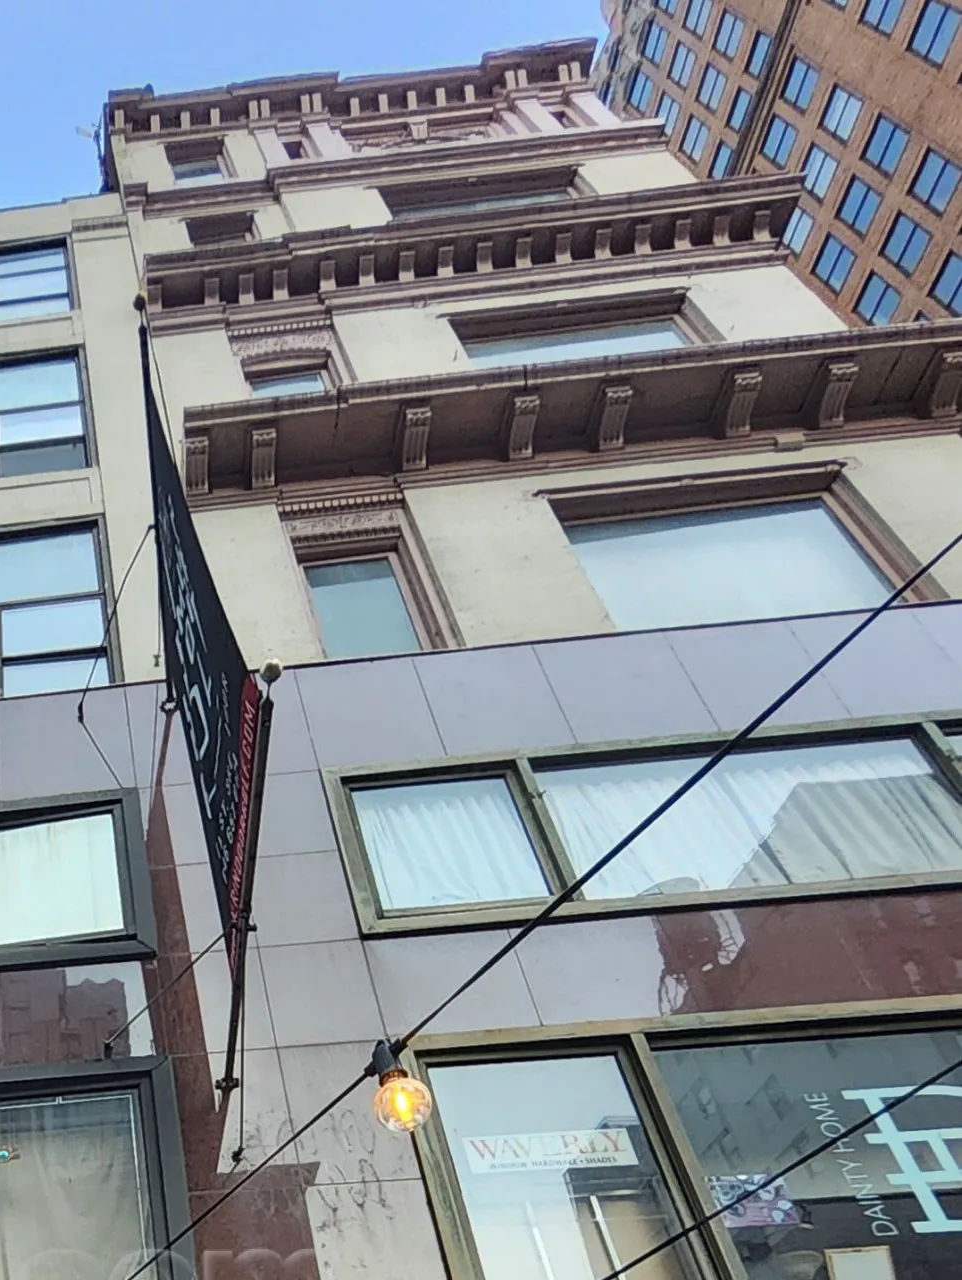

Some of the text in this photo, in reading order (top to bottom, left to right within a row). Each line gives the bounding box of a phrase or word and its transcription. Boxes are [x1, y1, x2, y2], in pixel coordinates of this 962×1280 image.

[469, 1130, 628, 1161] WAVERLY
[585, 1155, 618, 1165] SHADES
[805, 1092, 899, 1236] DAINTY HOME
